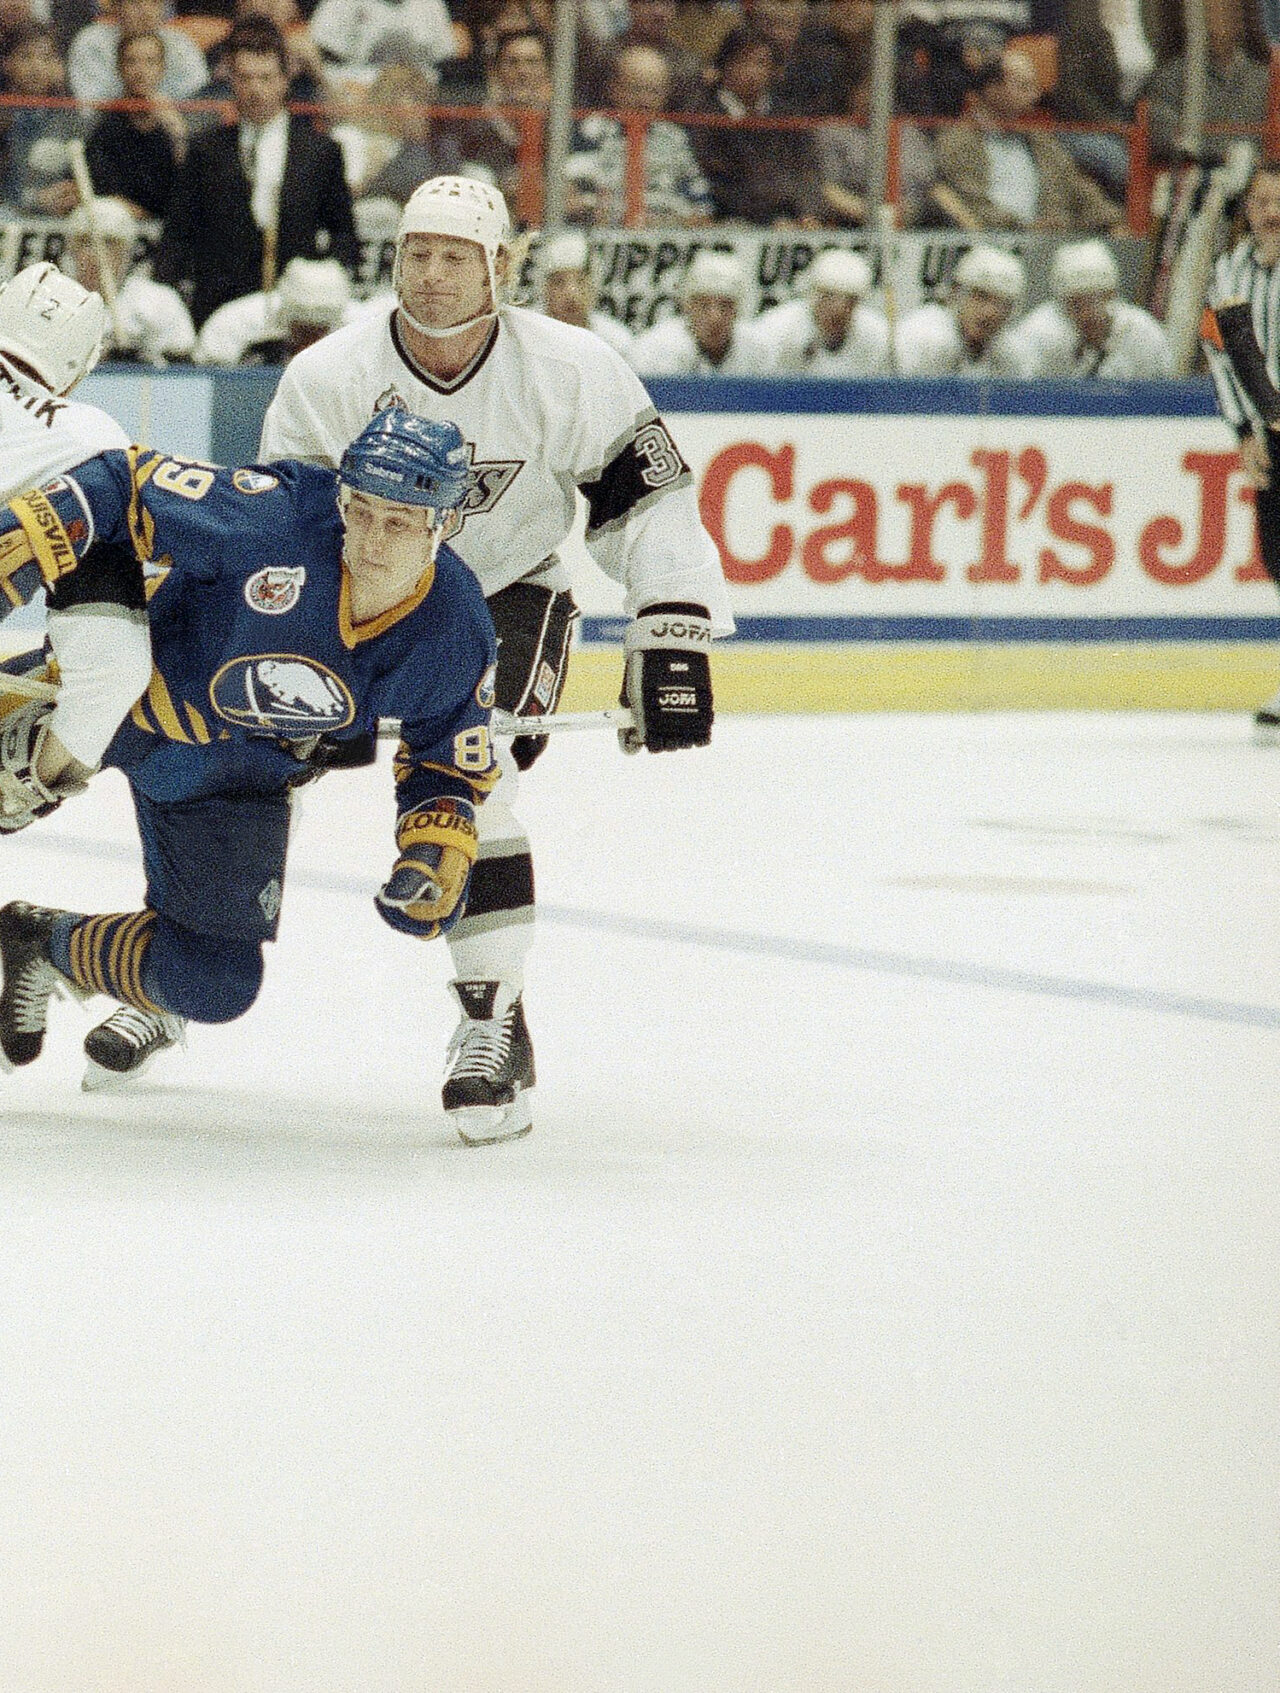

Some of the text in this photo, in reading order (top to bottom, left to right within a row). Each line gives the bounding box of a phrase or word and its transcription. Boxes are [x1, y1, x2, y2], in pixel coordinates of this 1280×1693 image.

[635, 424, 682, 487] 3
[699, 441, 1117, 585] Carl's
[658, 693, 696, 705] JOFA
